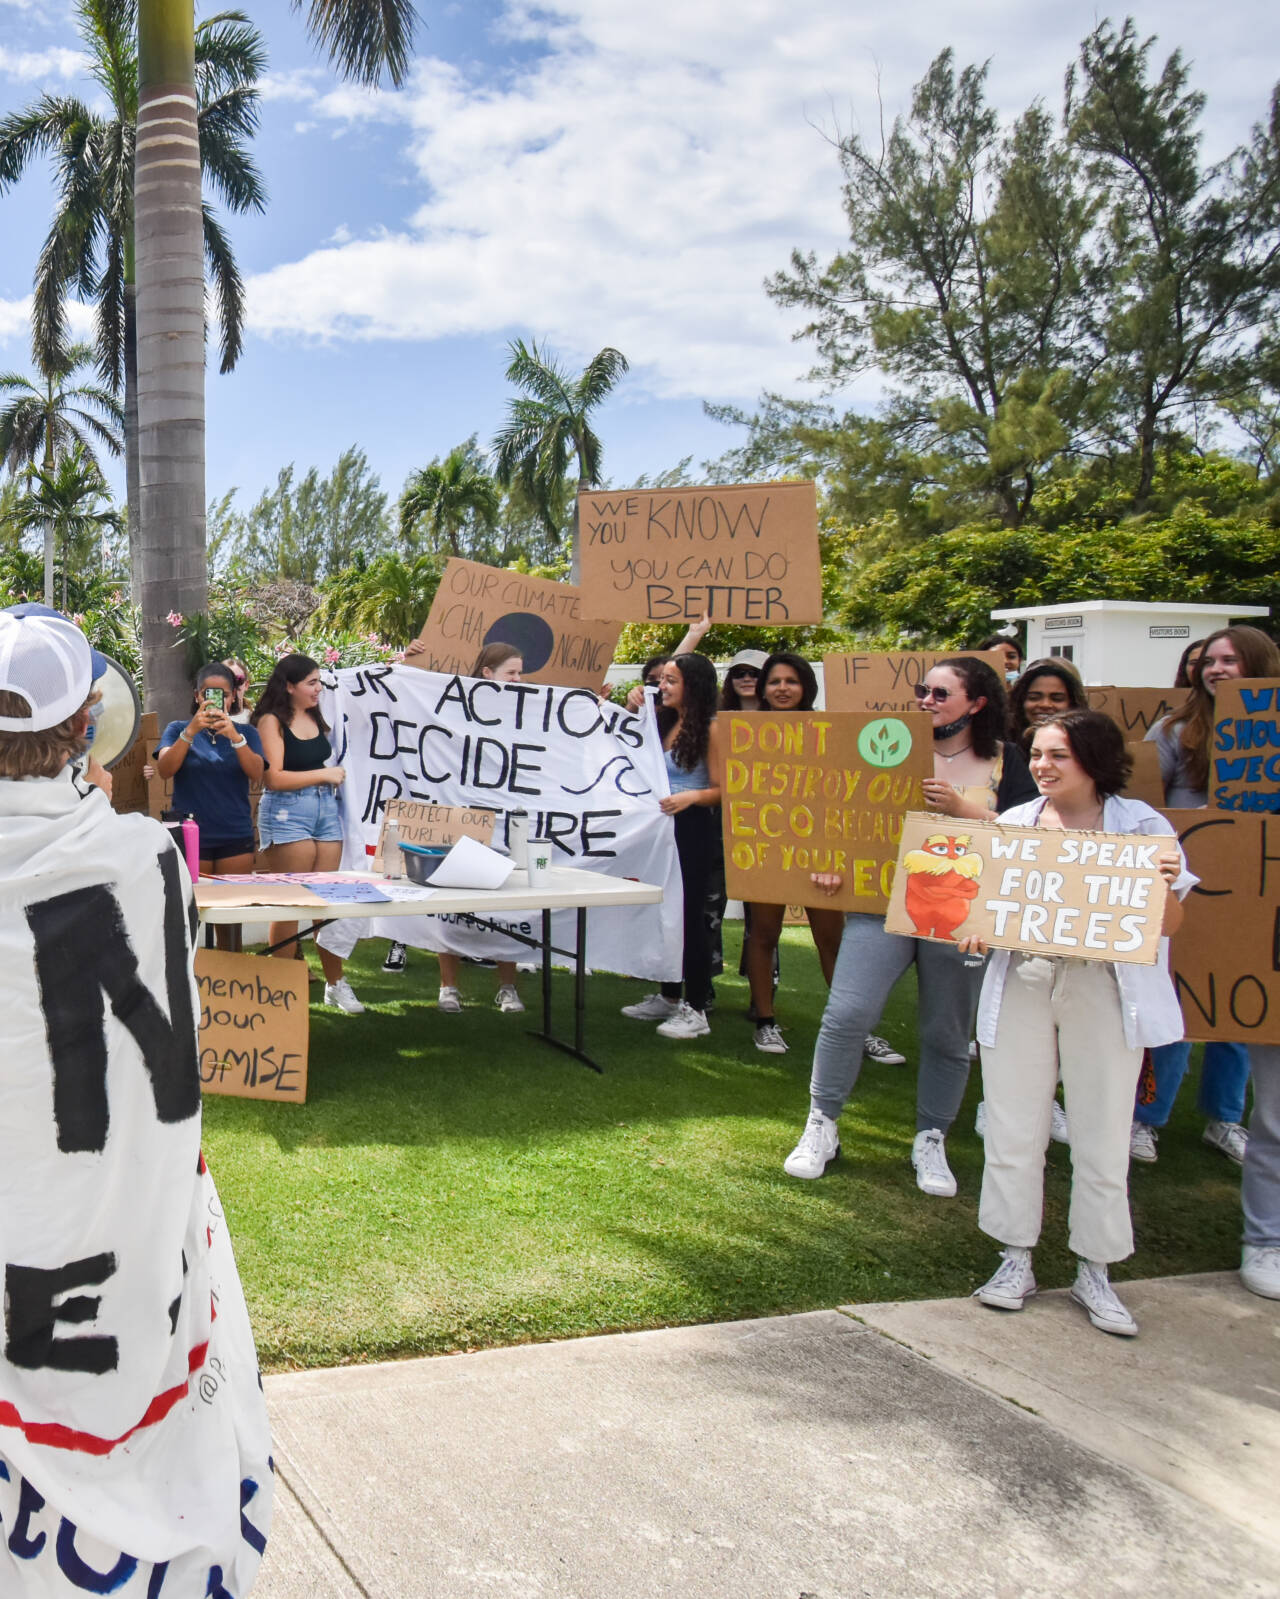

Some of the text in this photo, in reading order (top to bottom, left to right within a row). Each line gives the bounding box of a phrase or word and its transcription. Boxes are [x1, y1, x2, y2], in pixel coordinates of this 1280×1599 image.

[587, 521, 626, 546] YOU
[592, 496, 770, 540] WE KNOW
[676, 556, 733, 580] CAN
[745, 551, 788, 581] DO
[450, 567, 581, 620] OUR CLIMATE
[647, 585, 789, 620] BETTER
[844, 657, 870, 684] IF
[370, 712, 546, 796] DECIDE
[730, 718, 832, 755] DON'T
[726, 759, 862, 801] DESTROY
[382, 823, 435, 842] FTURE
[387, 799, 492, 829] PROTECT OUR
[730, 801, 905, 845] ECO BECAU
[731, 841, 770, 870] OF
[781, 844, 847, 871] YOUR
[991, 836, 1159, 870] WE SPEAK
[999, 867, 1154, 909] FOR THE
[985, 900, 1149, 952] TREES
[200, 1046, 301, 1091] OMISE
